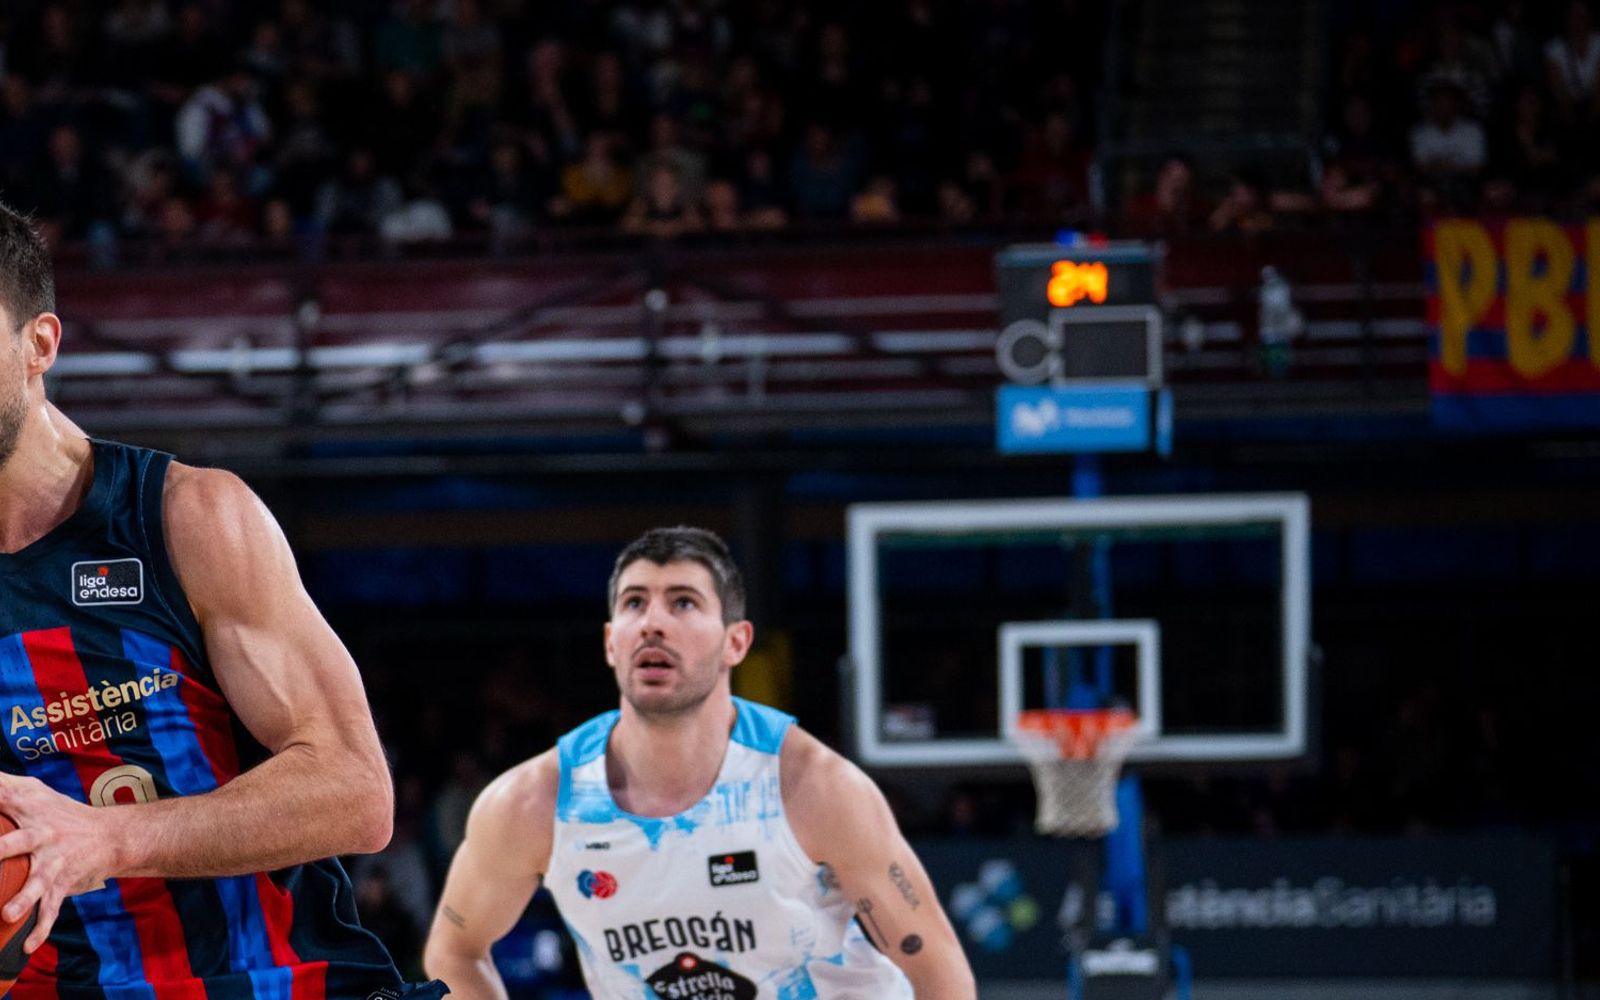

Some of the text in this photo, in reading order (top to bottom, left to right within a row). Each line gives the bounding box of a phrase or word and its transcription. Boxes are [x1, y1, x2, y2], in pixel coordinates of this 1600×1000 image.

[79, 574, 106, 590] liga
[79, 584, 138, 599] endesa
[9, 668, 179, 736] Assistència
[16, 707, 138, 761] Sanitària
